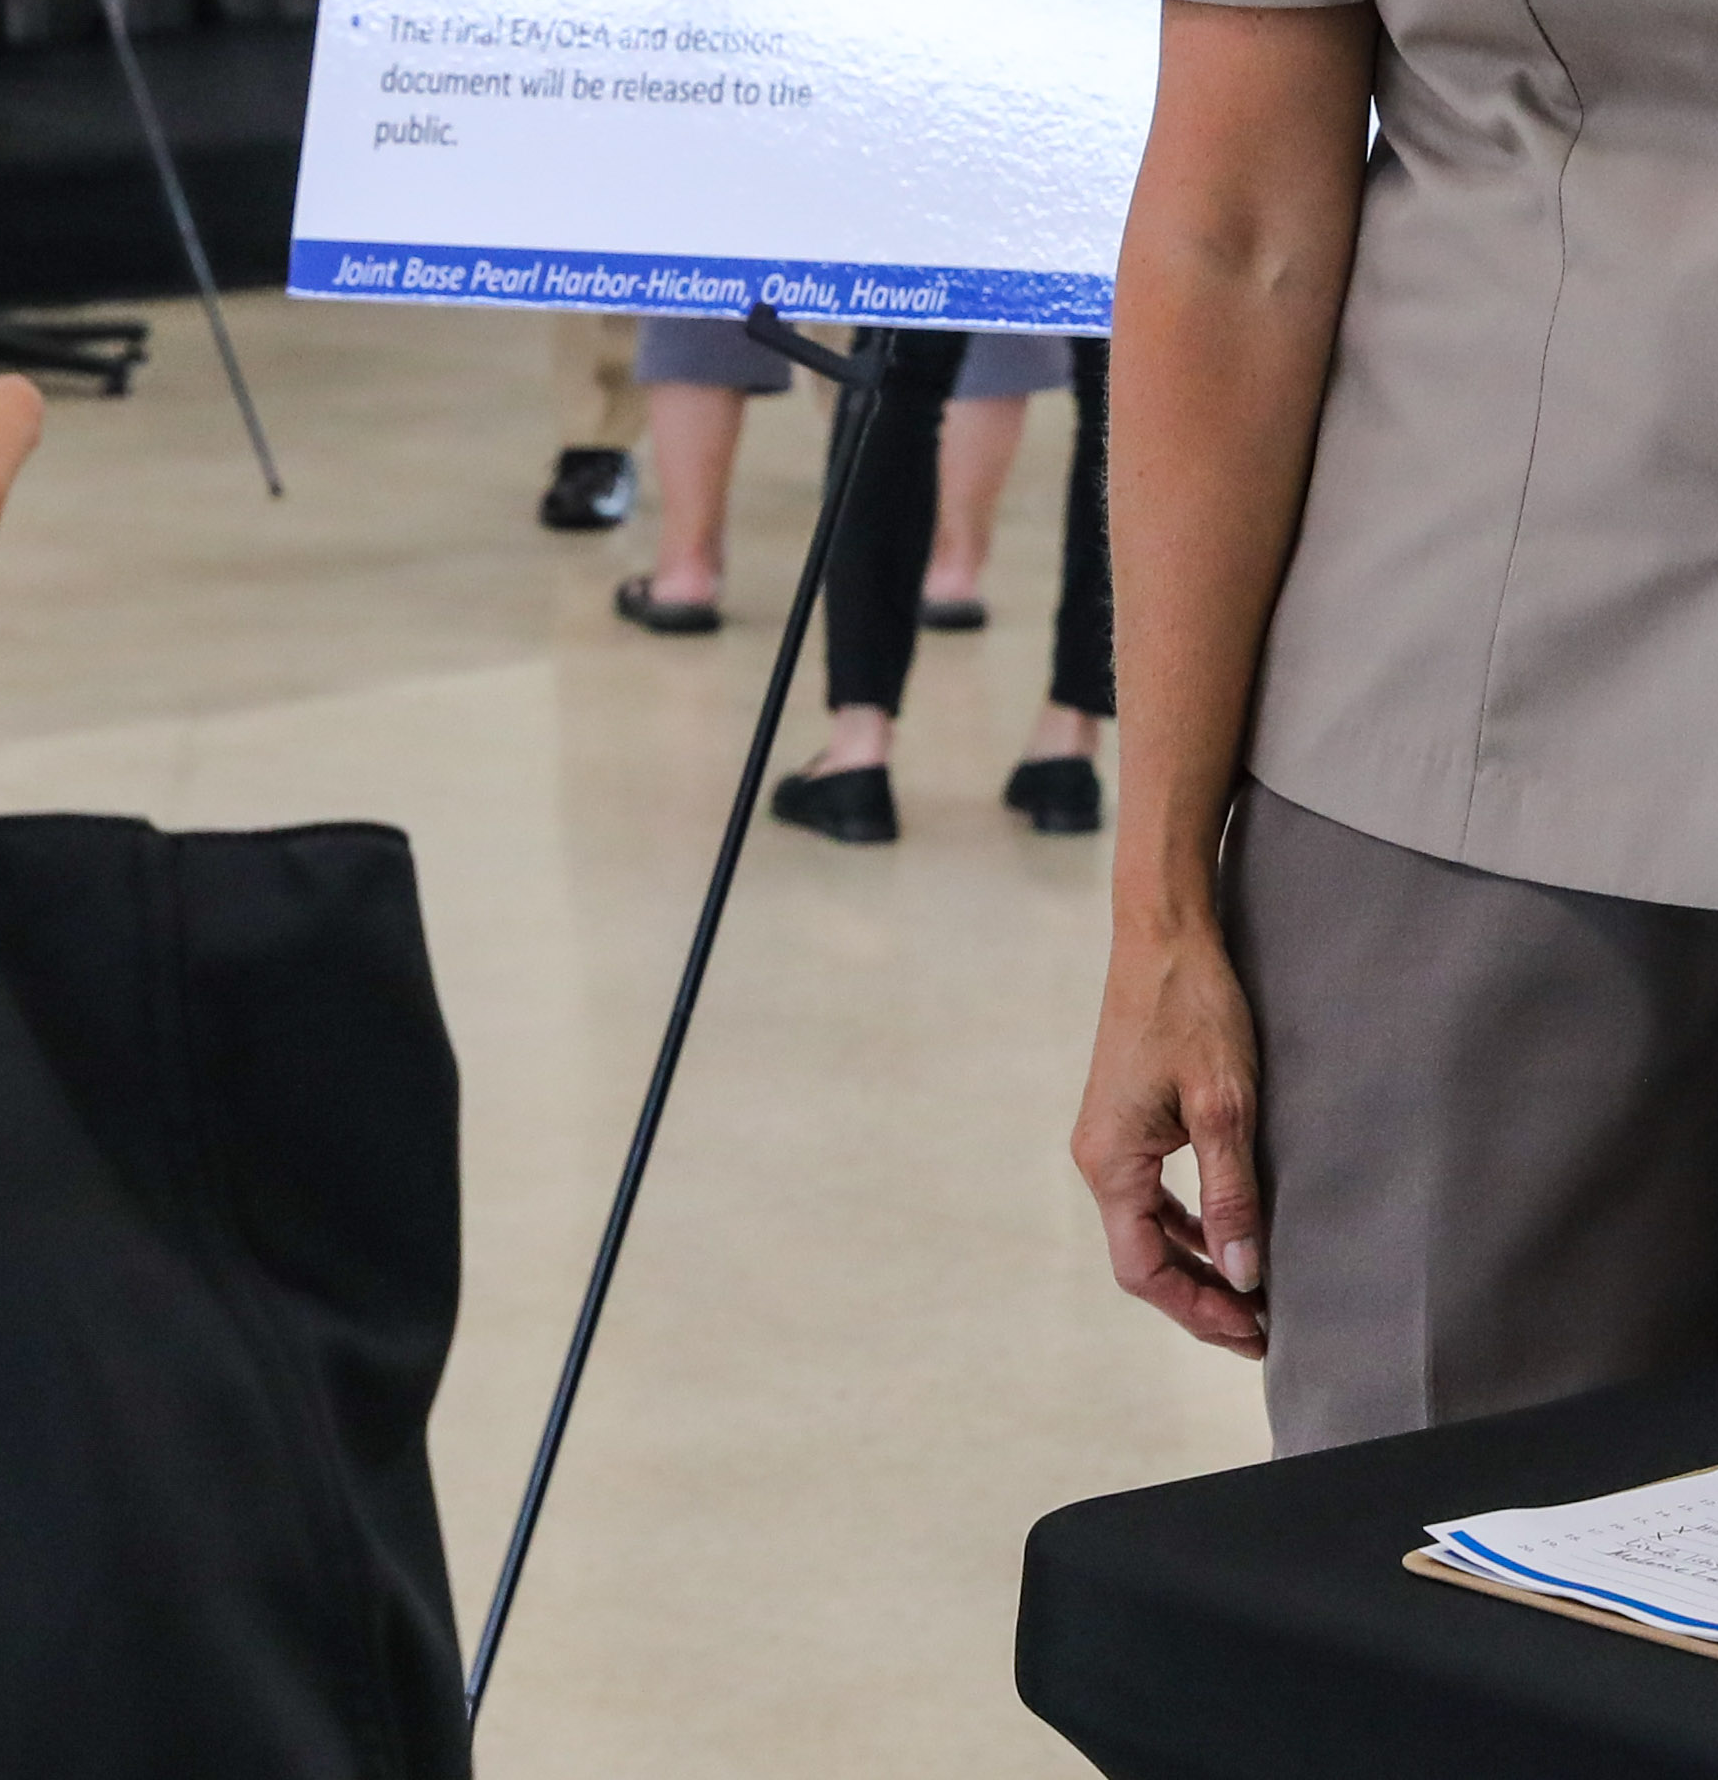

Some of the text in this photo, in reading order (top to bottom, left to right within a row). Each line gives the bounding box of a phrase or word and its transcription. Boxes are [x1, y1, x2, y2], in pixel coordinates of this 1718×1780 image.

[381, 64, 813, 108] document will be released to the
[374, 114, 457, 149] public.
[332, 255, 950, 313] Joint Base Pearl Harbor-Hickam, Oahu, Hawaii
